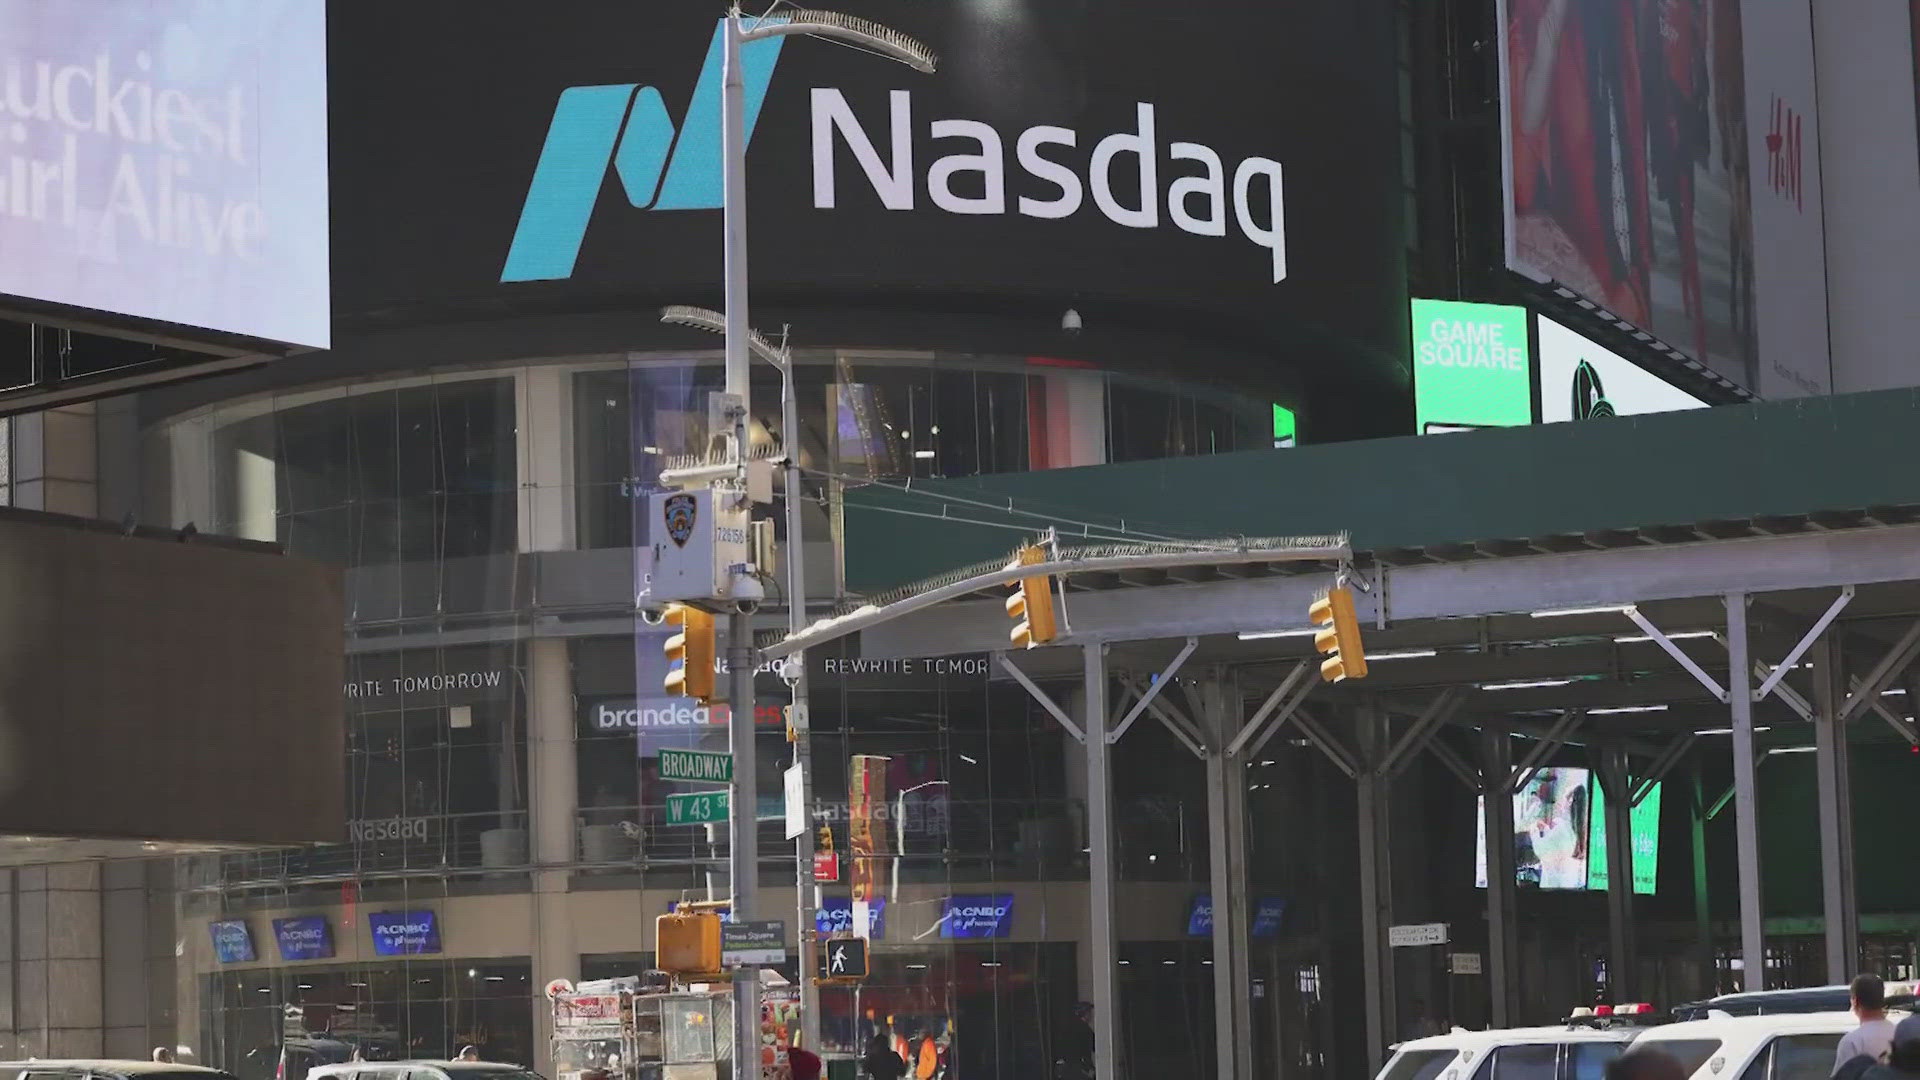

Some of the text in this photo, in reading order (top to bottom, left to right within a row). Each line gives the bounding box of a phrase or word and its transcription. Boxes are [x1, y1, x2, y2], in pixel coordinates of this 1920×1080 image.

[0, 46, 250, 166] uckiest
[1765, 92, 1803, 215] H&M
[0, 122, 268, 263] irl Alive
[809, 87, 1287, 284] Nasdaq
[1430, 319, 1504, 349] GAME
[1420, 340, 1522, 371] SQUARE
[824, 658, 989, 674] REWRITE TOMOR
[393, 671, 501, 694] TOMORROW
[661, 752, 729, 780] BROADWAY
[670, 799, 683, 822] W
[689, 797, 711, 820] 43
[350, 817, 427, 843] Nasdaq
